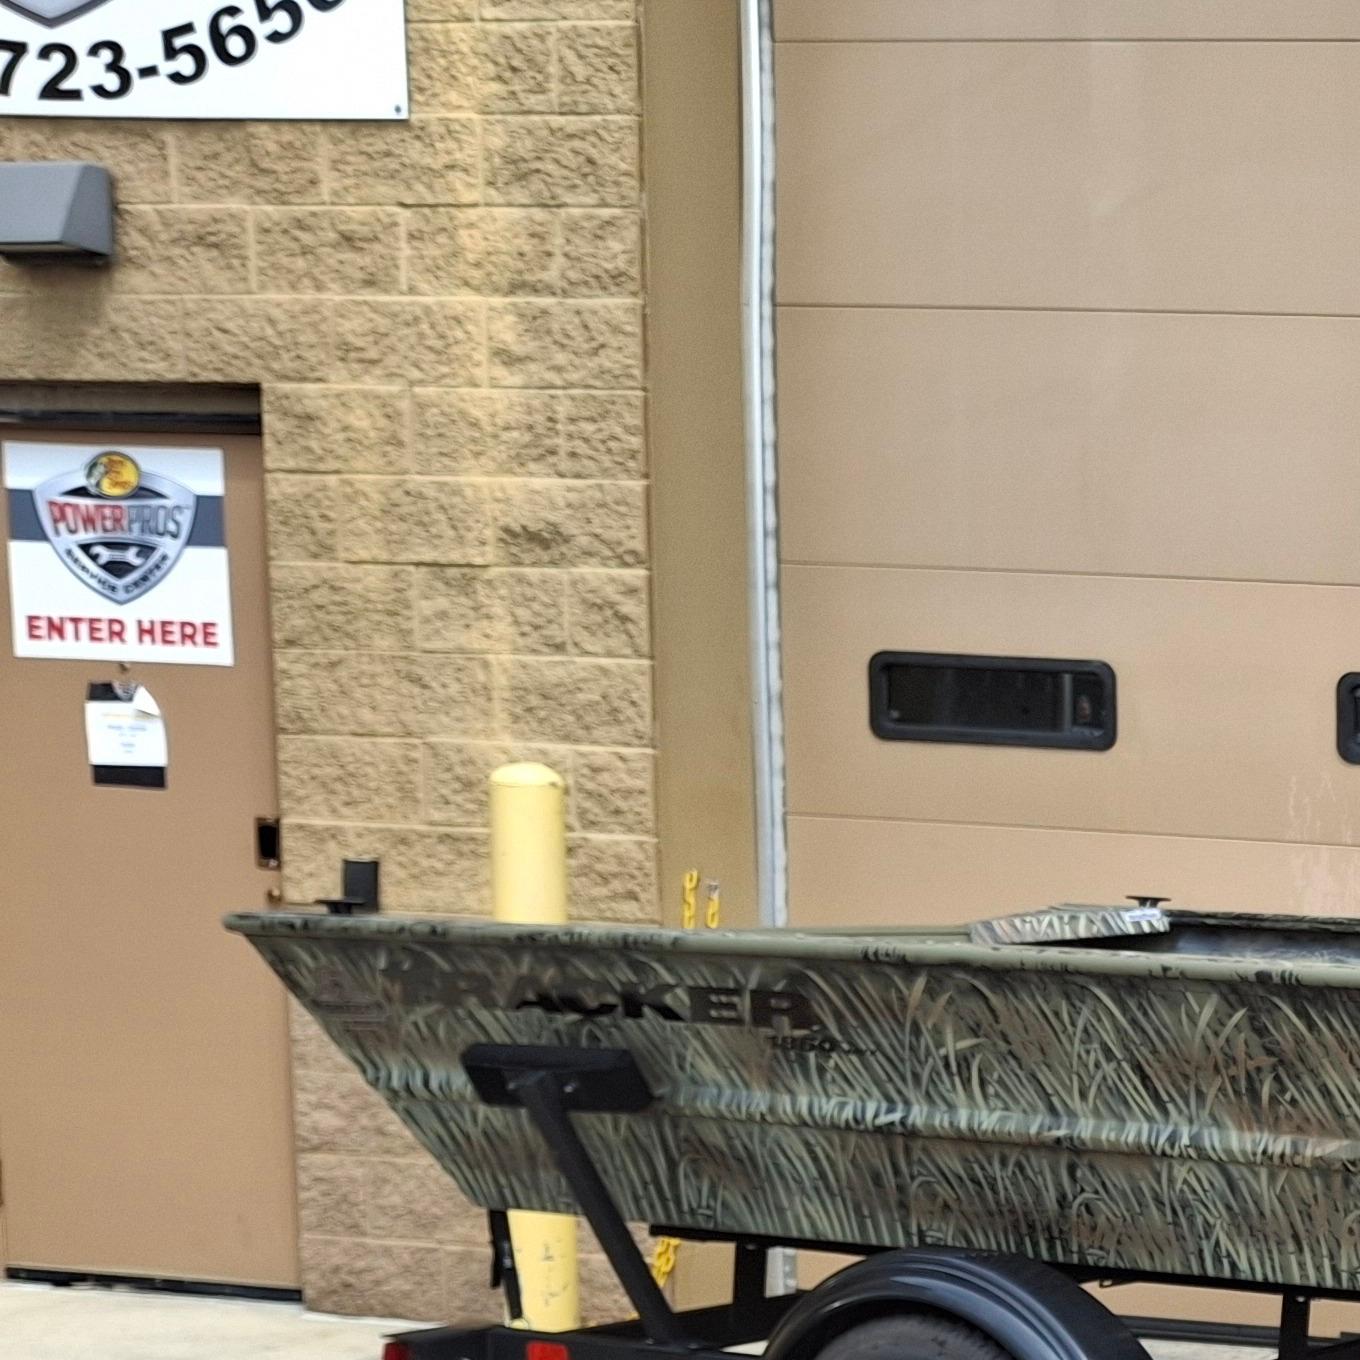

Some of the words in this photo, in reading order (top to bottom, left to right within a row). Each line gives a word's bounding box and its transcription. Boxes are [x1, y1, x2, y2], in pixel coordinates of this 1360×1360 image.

[0, 0, 347, 101] 723-565
[26, 614, 126, 644] ENTER
[137, 620, 219, 647] HERE
